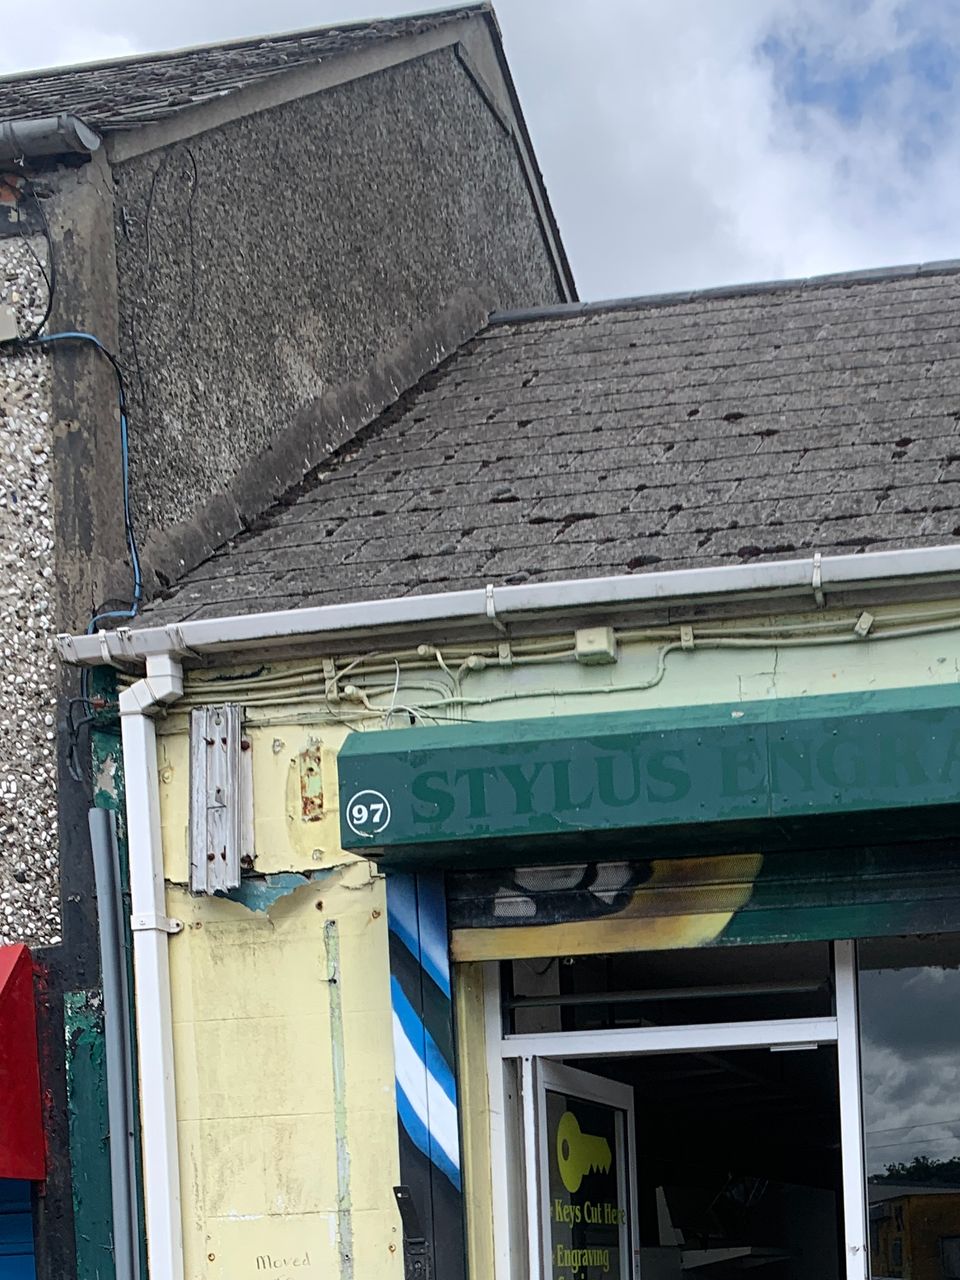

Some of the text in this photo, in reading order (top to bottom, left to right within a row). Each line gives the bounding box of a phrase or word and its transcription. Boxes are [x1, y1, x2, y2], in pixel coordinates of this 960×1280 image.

[411, 747, 691, 825] STYLUS
[352, 802, 384, 825] 97
[555, 1199, 626, 1228] Keys Cut Here
[557, 1244, 609, 1272] Engraving
